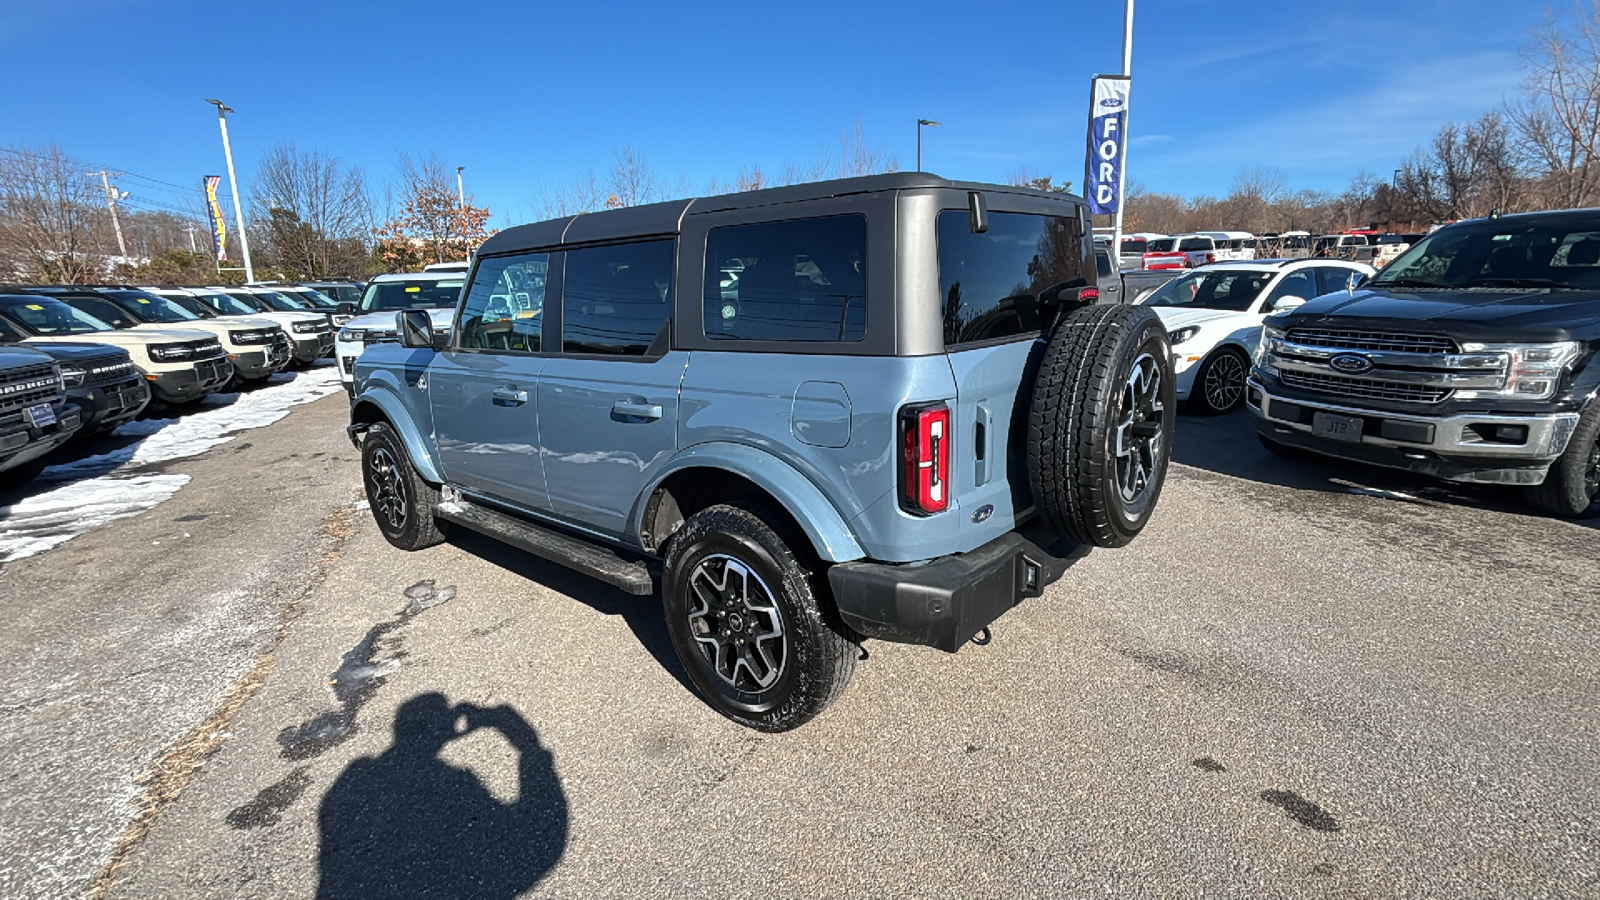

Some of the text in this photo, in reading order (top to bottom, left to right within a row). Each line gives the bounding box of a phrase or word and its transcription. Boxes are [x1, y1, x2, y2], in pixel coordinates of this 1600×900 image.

[1097, 118, 1118, 204] FORD
[0, 378, 54, 394] RONCO
[1327, 421, 1348, 436] JTR
